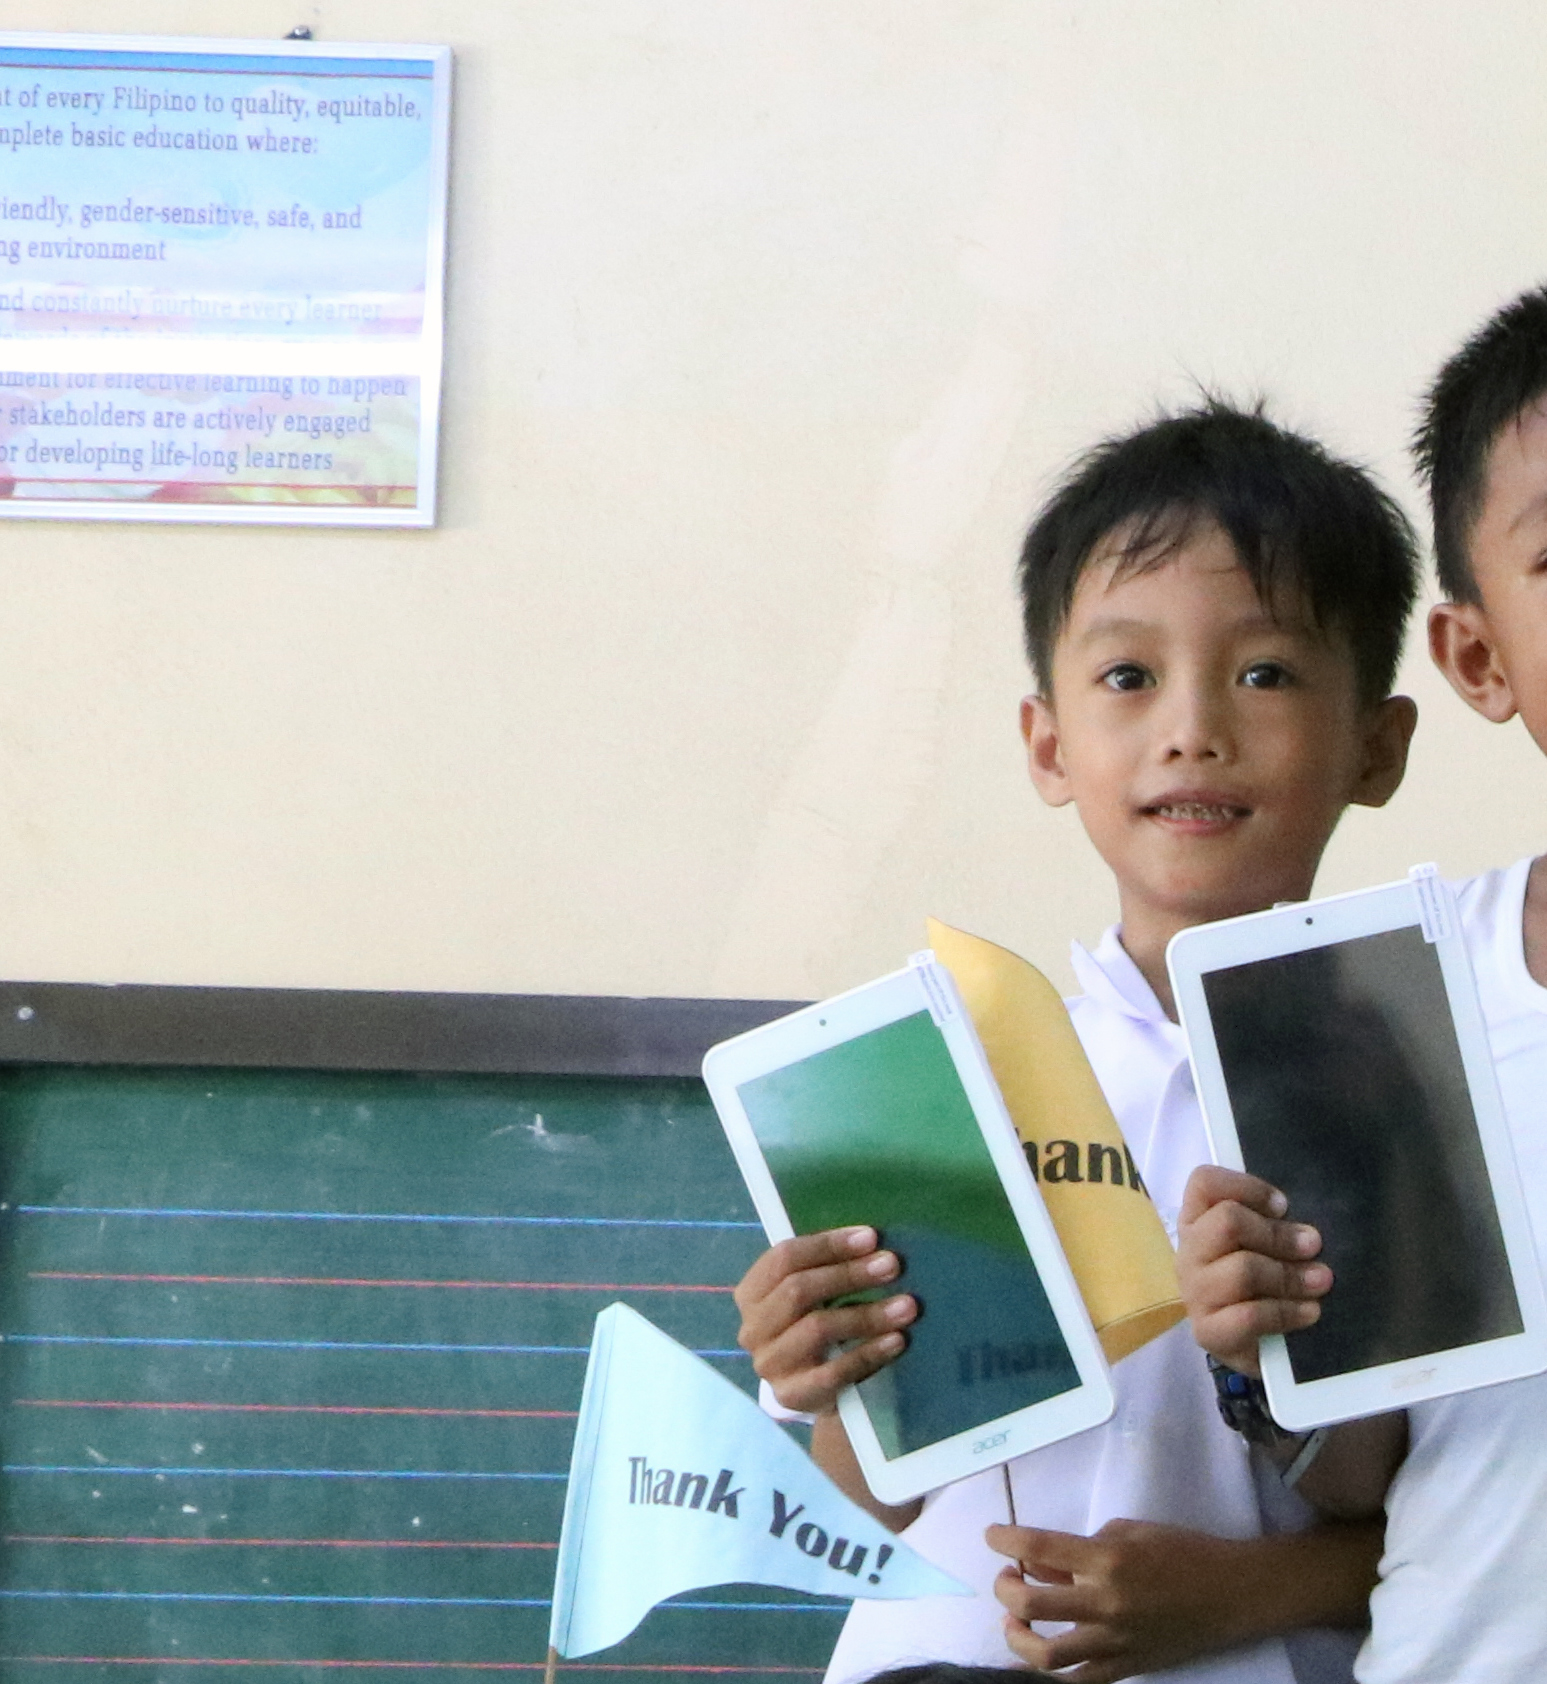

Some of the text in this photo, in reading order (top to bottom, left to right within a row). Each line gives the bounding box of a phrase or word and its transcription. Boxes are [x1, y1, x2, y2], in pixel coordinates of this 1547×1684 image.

[18, 83, 41, 107] of
[46, 91, 105, 116] every
[113, 86, 197, 114] Filipino
[204, 92, 225, 114] to
[231, 88, 310, 121] quality,
[317, 92, 422, 123] equitable,
[71, 121, 125, 148] basic
[133, 126, 238, 152] education
[247, 127, 318, 154] where:
[0, 195, 362, 231] iendly, gender-sensitive, safe, and
[28, 236, 166, 261] environment
[301, 376, 321, 397] to
[9, 400, 372, 439] stakeholders are actively engaged
[25, 438, 143, 472] developing
[151, 440, 239, 473] life-long
[245, 443, 334, 471] learners
[971, 1428, 1011, 1454] acer
[628, 1456, 895, 1585] Thank You!
